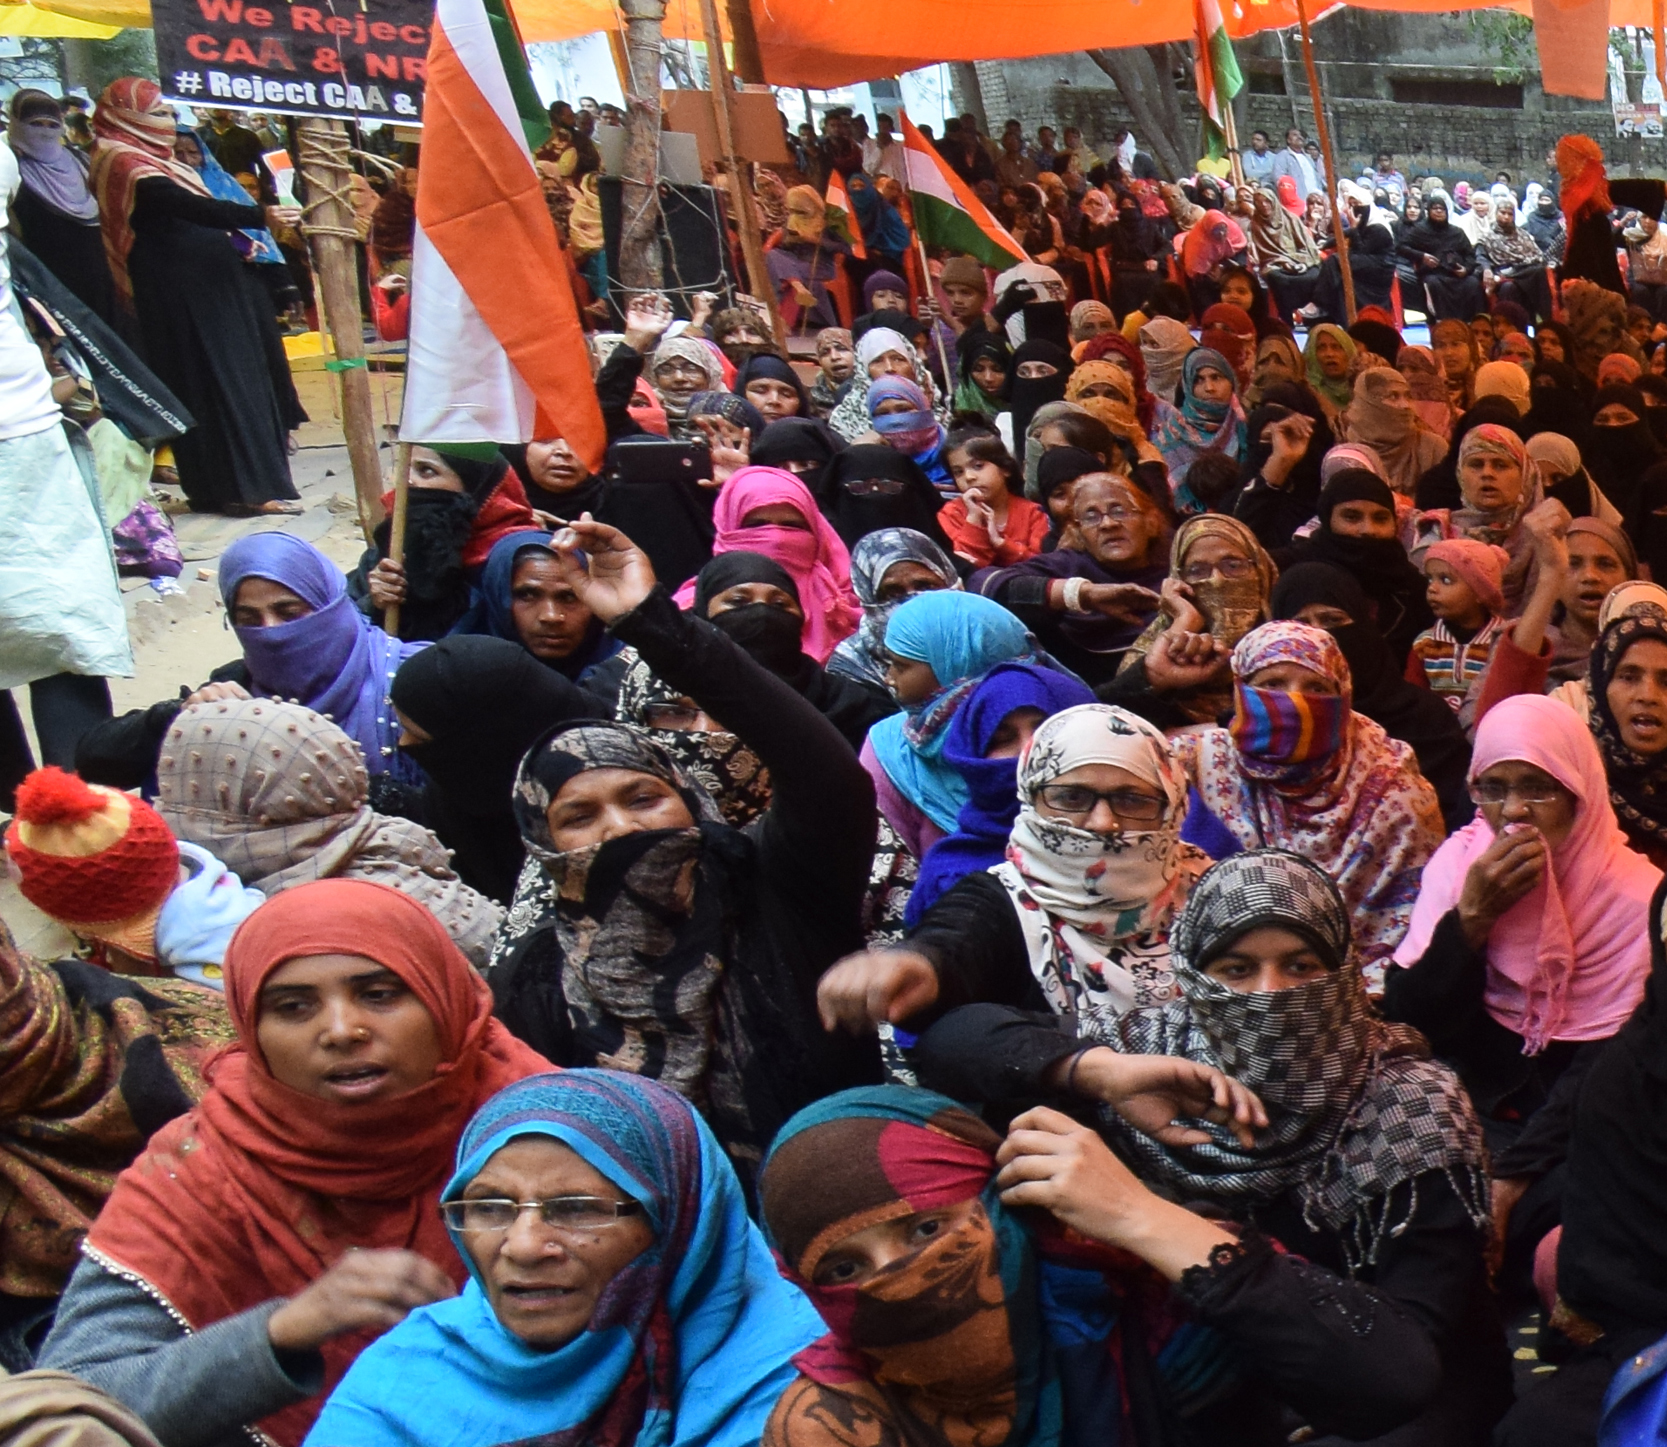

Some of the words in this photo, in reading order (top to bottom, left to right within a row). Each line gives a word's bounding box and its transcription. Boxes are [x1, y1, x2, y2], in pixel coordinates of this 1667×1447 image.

[196, 0, 274, 27] We
[290, 5, 434, 45] Rejec
[185, 34, 296, 71] CAA
[312, 47, 348, 73] &
[364, 52, 428, 81] NR
[207, 71, 318, 106] Reject
[324, 82, 389, 112] CAA
[393, 94, 418, 115] &
